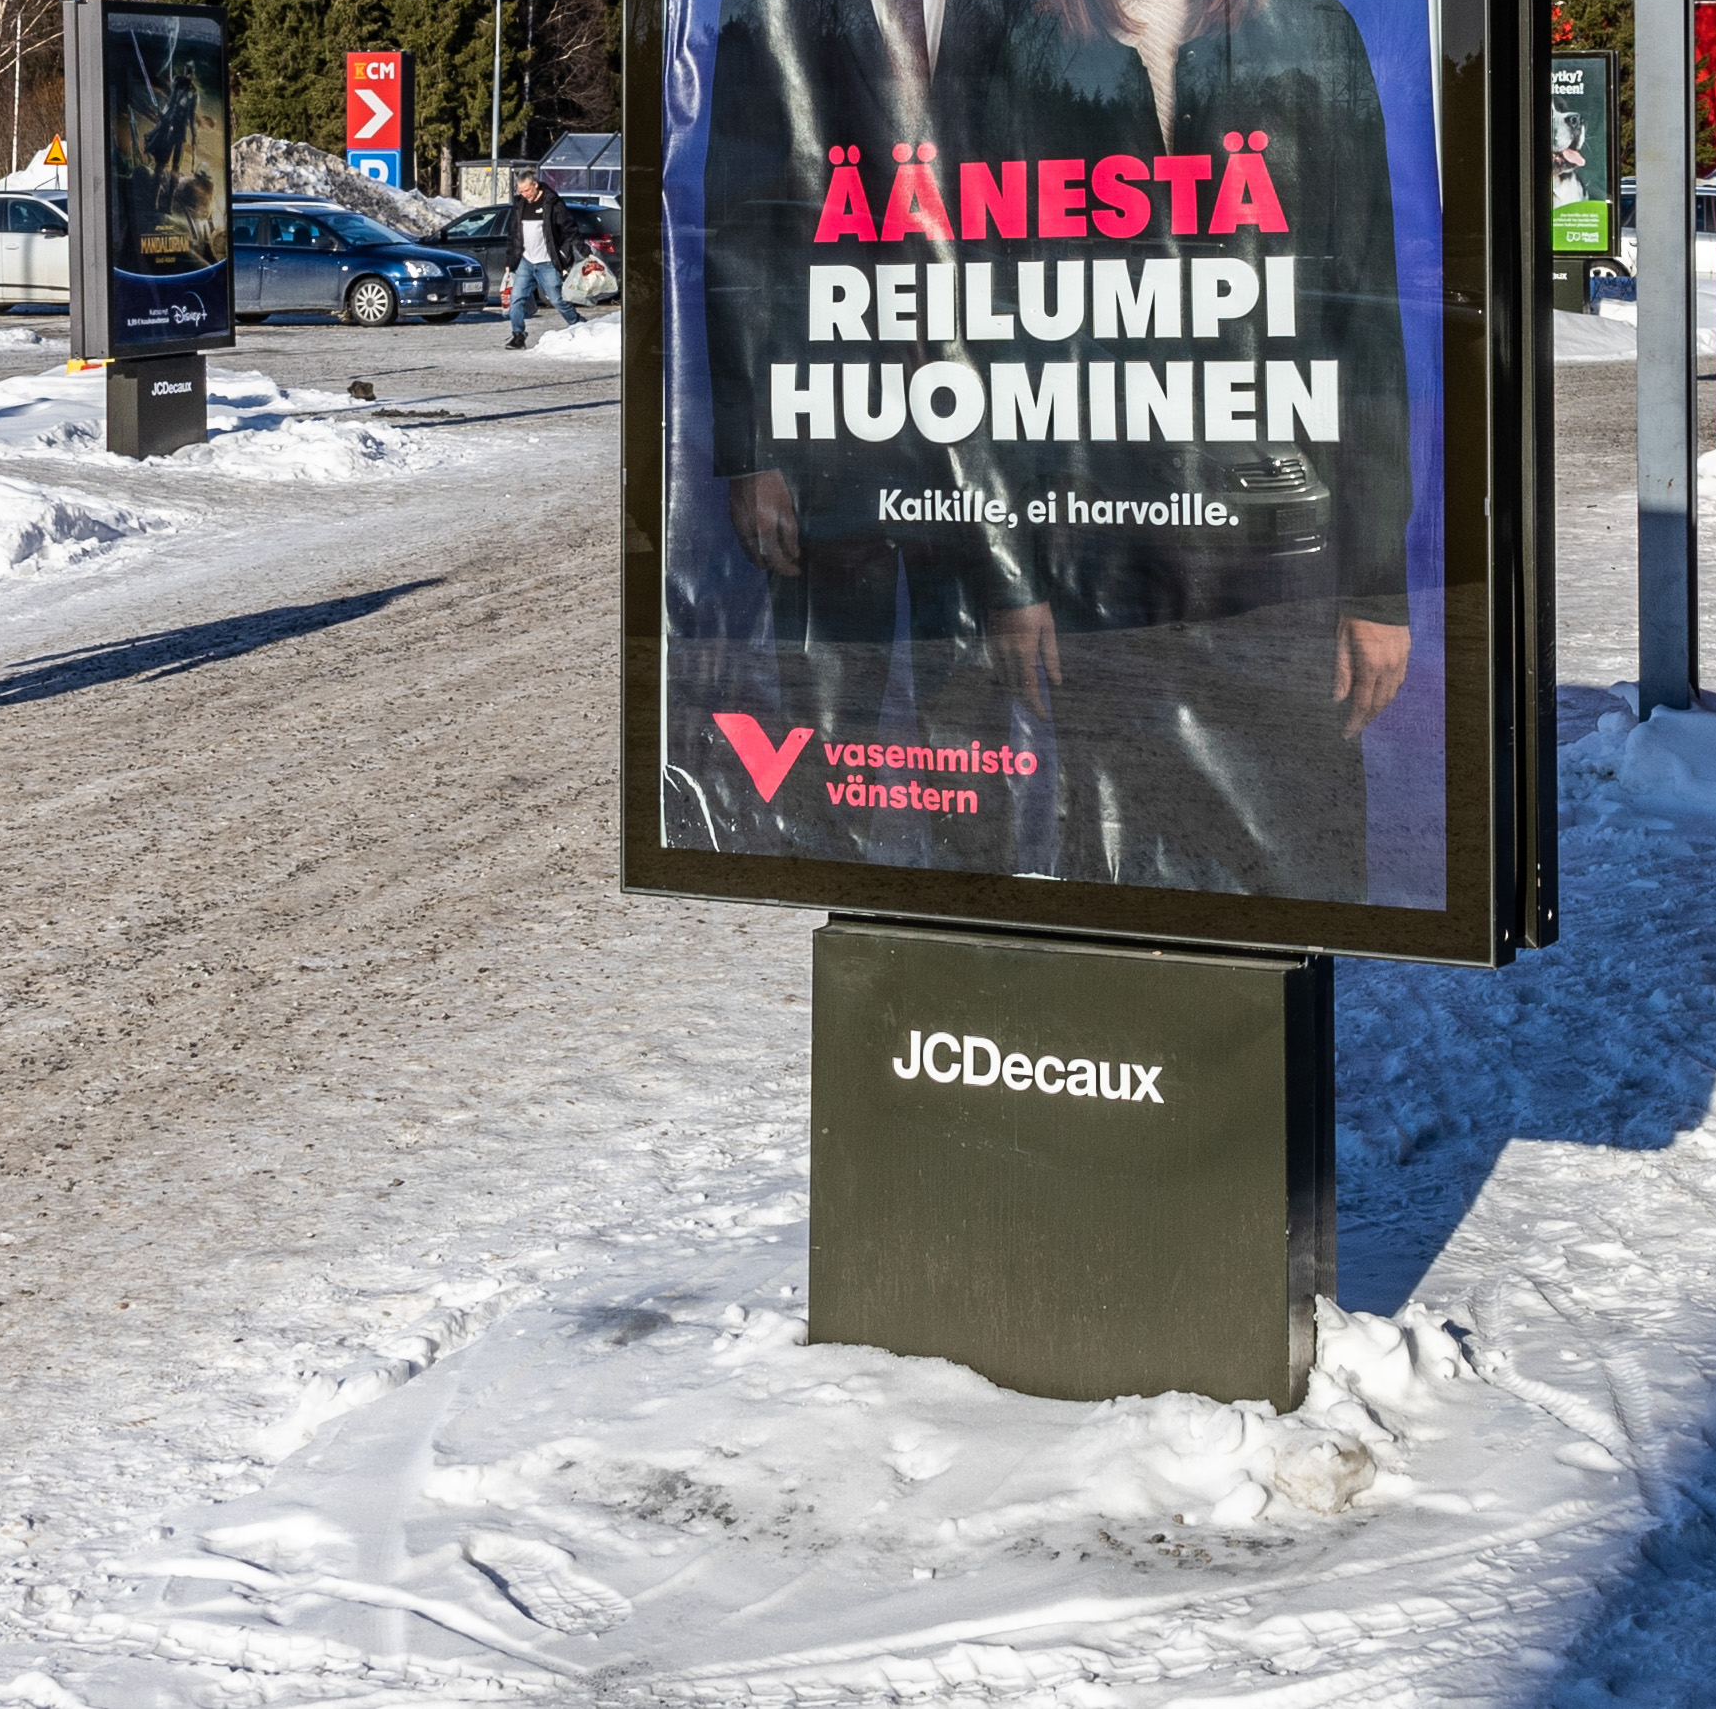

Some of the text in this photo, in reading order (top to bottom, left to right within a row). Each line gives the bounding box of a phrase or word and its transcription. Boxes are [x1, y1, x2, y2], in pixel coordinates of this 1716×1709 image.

[813, 130, 1290, 243] ÄÄNESTÄ
[808, 255, 1296, 342] REILUMPI
[151, 380, 192, 396] JCDecaux
[770, 358, 1340, 444] HUOMINEN
[878, 489, 1240, 529] Kaikille, ei harvoille.
[823, 740, 1038, 776] vasemmisto
[825, 774, 979, 814] vänstern
[891, 1029, 1166, 1105] JCDecaux
